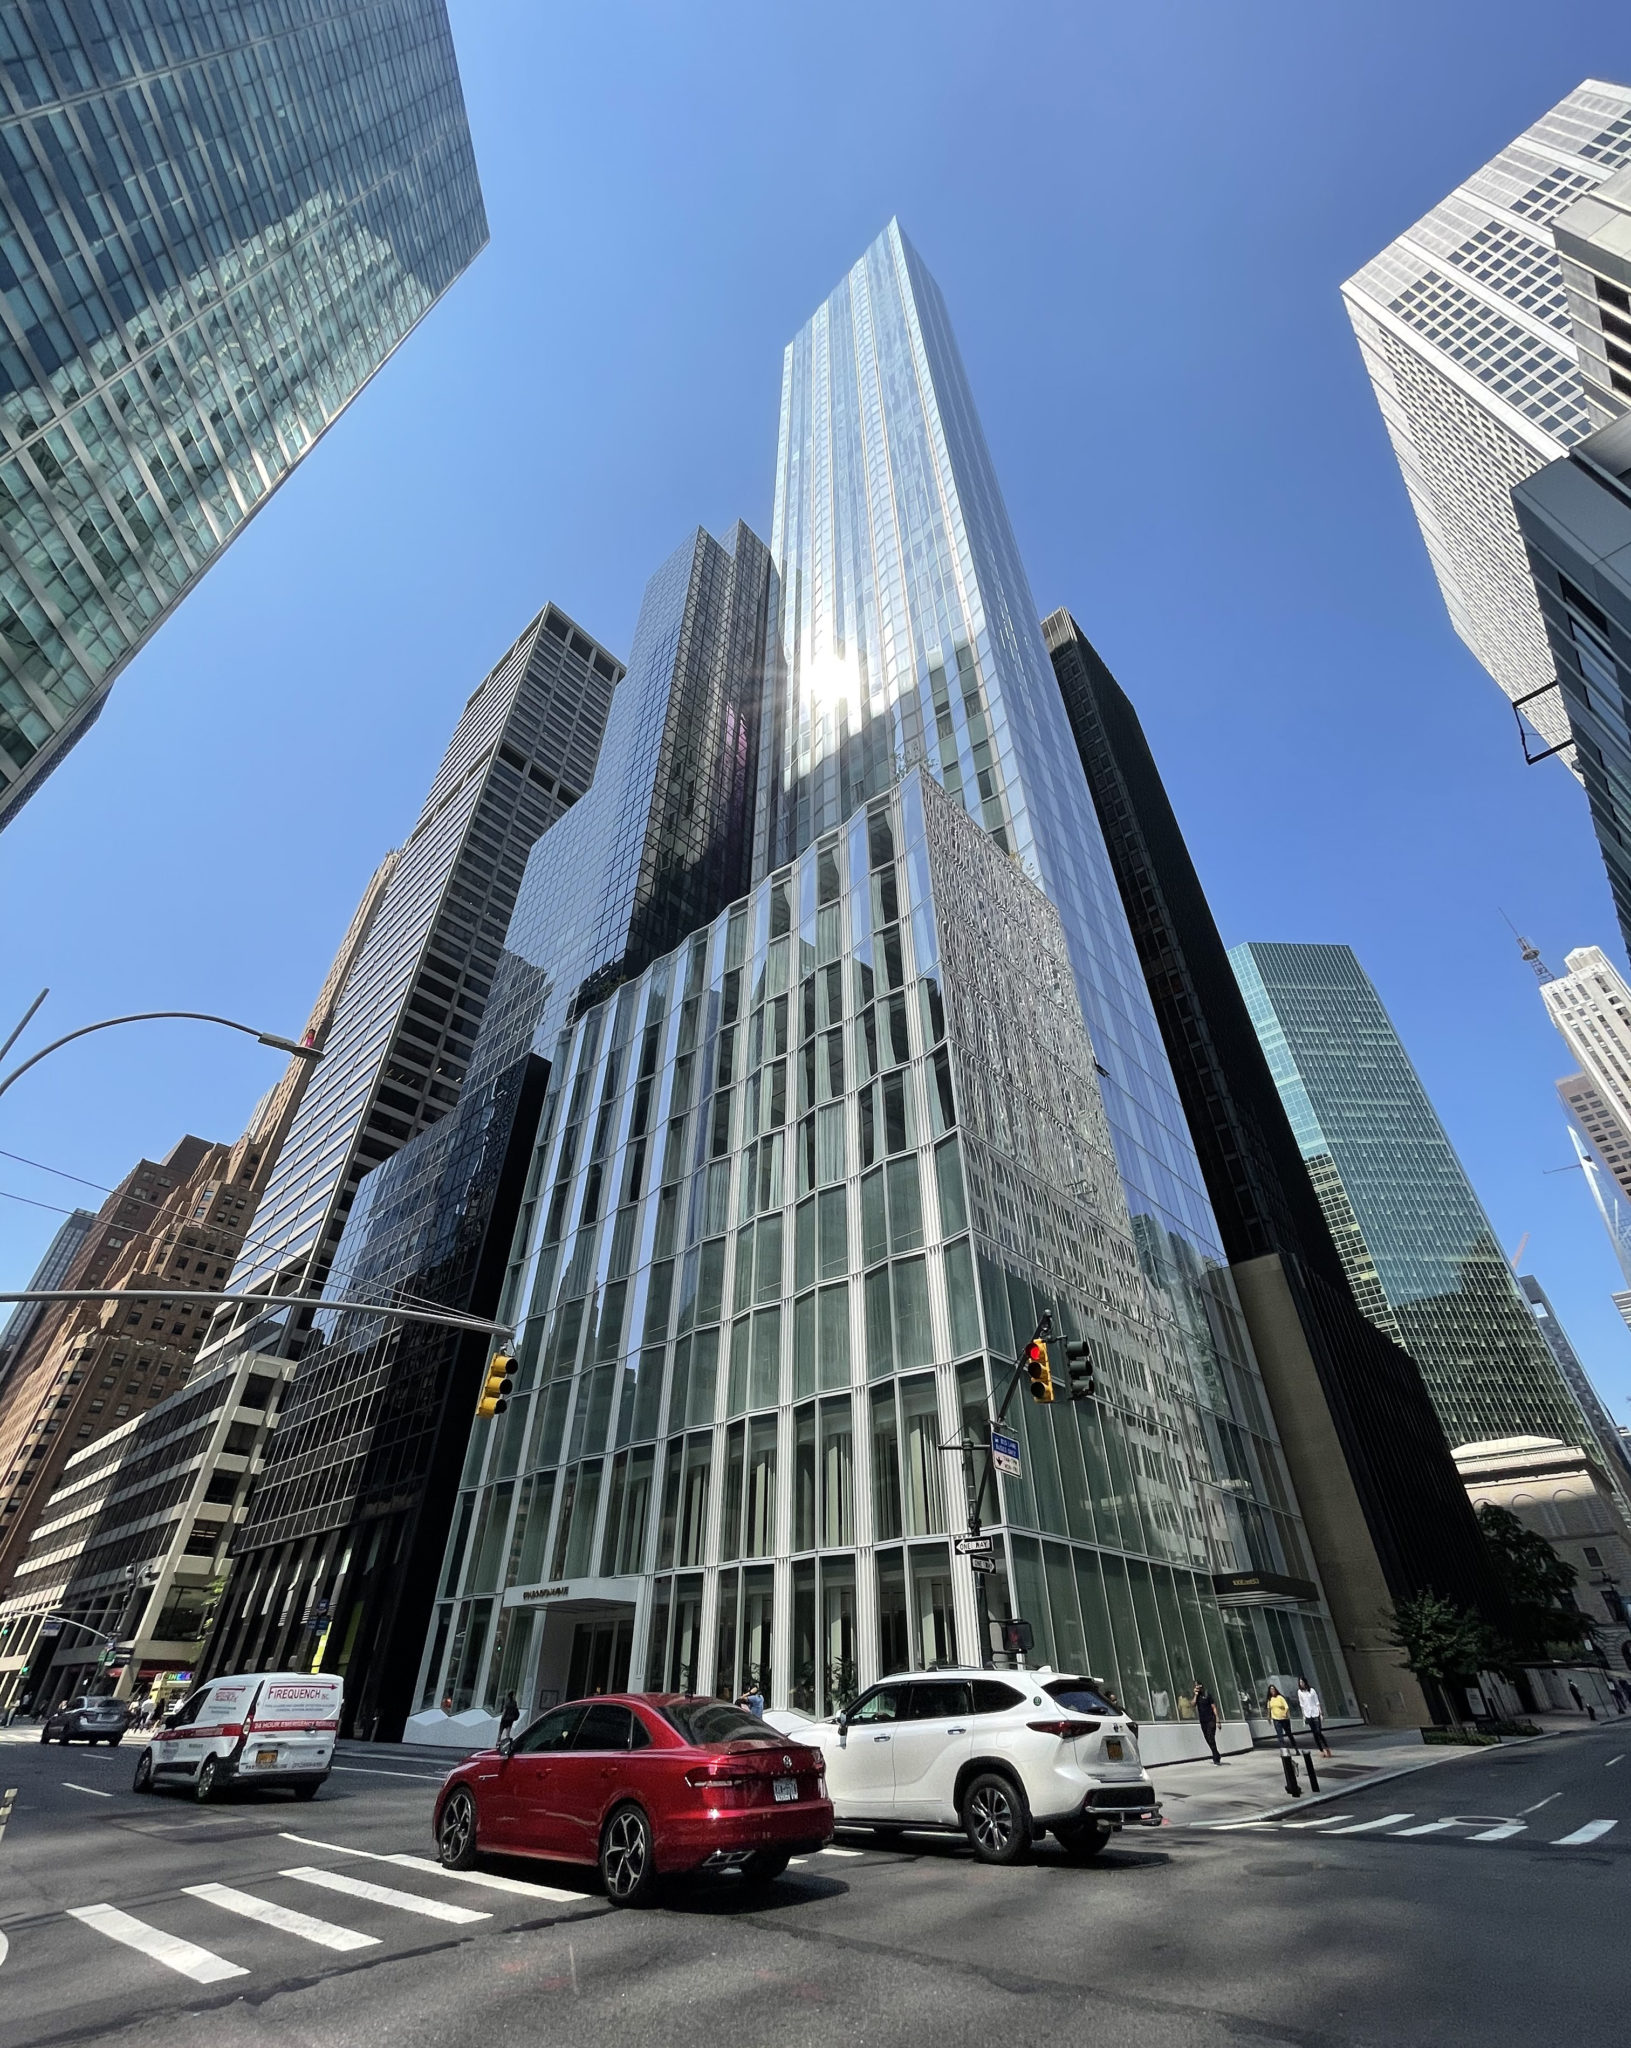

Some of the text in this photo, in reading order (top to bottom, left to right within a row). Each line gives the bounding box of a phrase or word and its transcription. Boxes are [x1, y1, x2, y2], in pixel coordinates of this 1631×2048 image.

[960, 1541, 988, 1551] ONE WAY
[268, 1686, 321, 1700] FIREQUENCH
